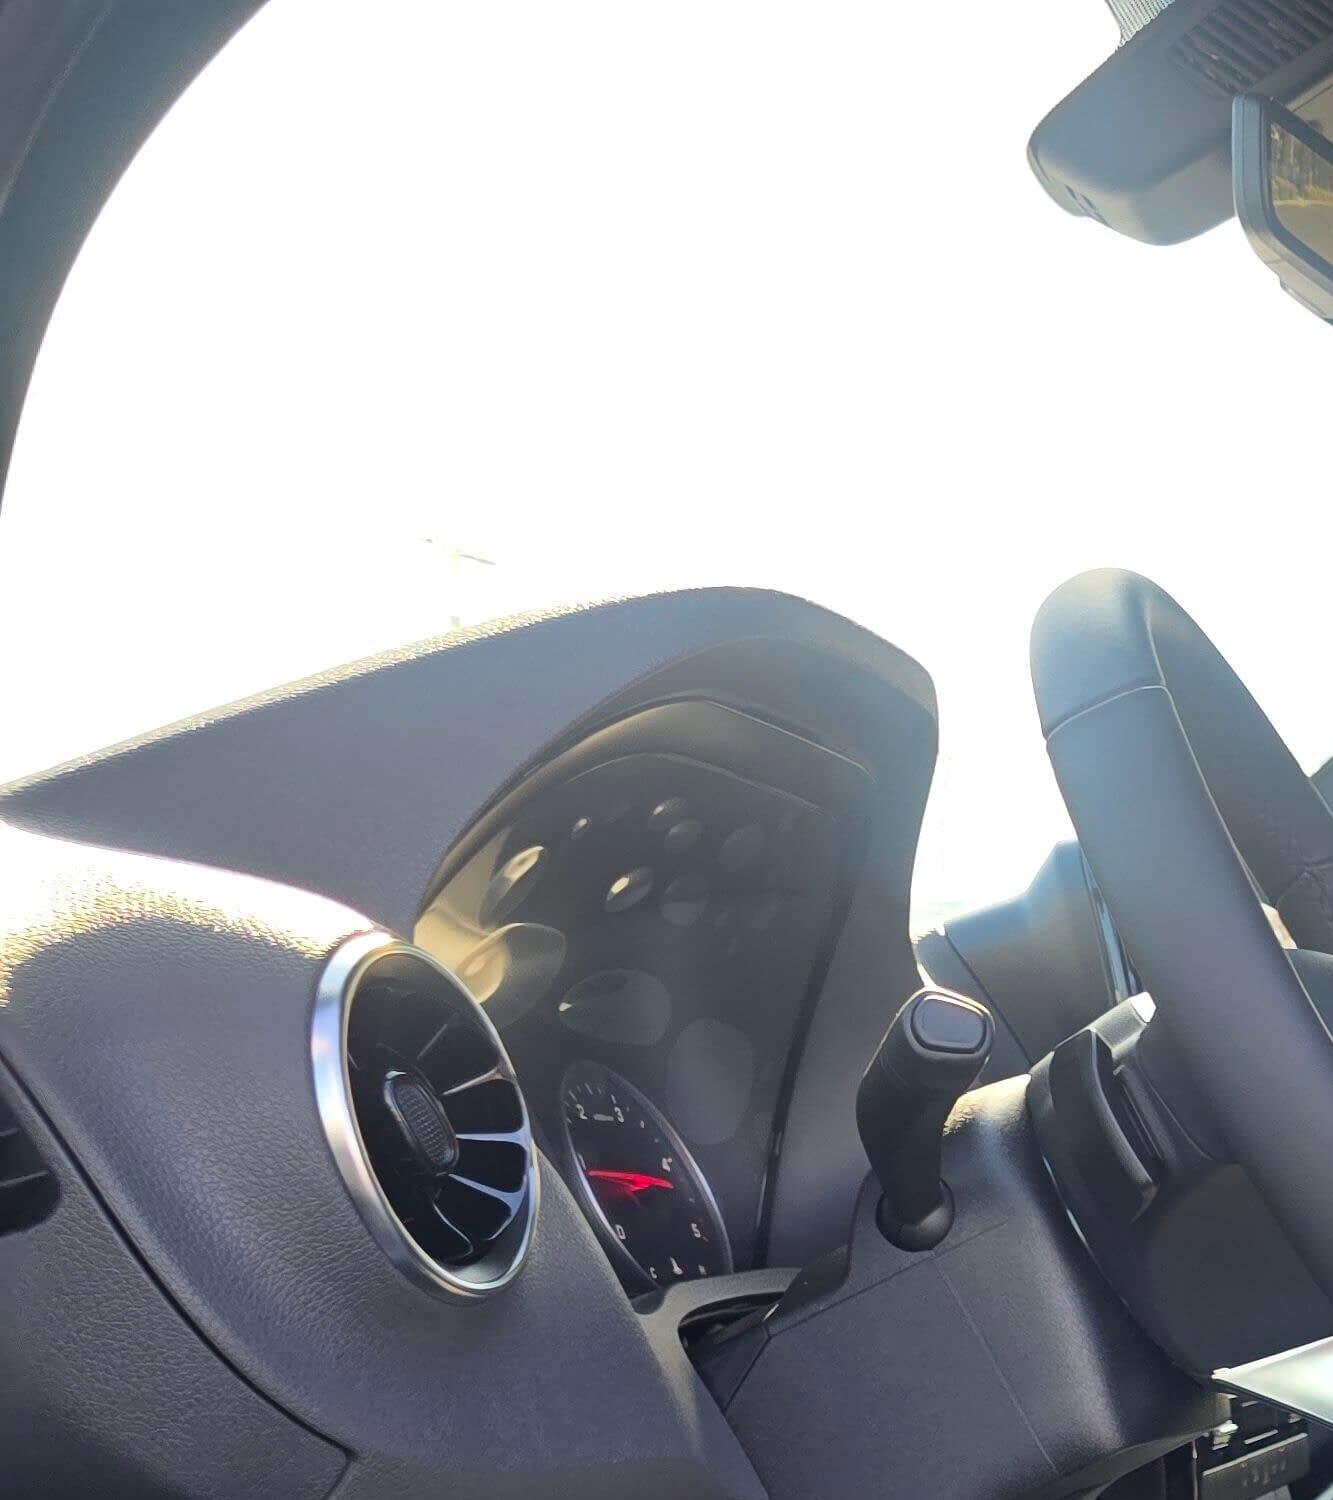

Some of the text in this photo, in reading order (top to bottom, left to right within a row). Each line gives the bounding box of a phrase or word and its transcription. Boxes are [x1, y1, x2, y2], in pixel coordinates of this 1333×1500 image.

[576, 1103, 588, 1120] 2
[614, 1106, 625, 1123] 3
[691, 1223, 702, 1238] 5
